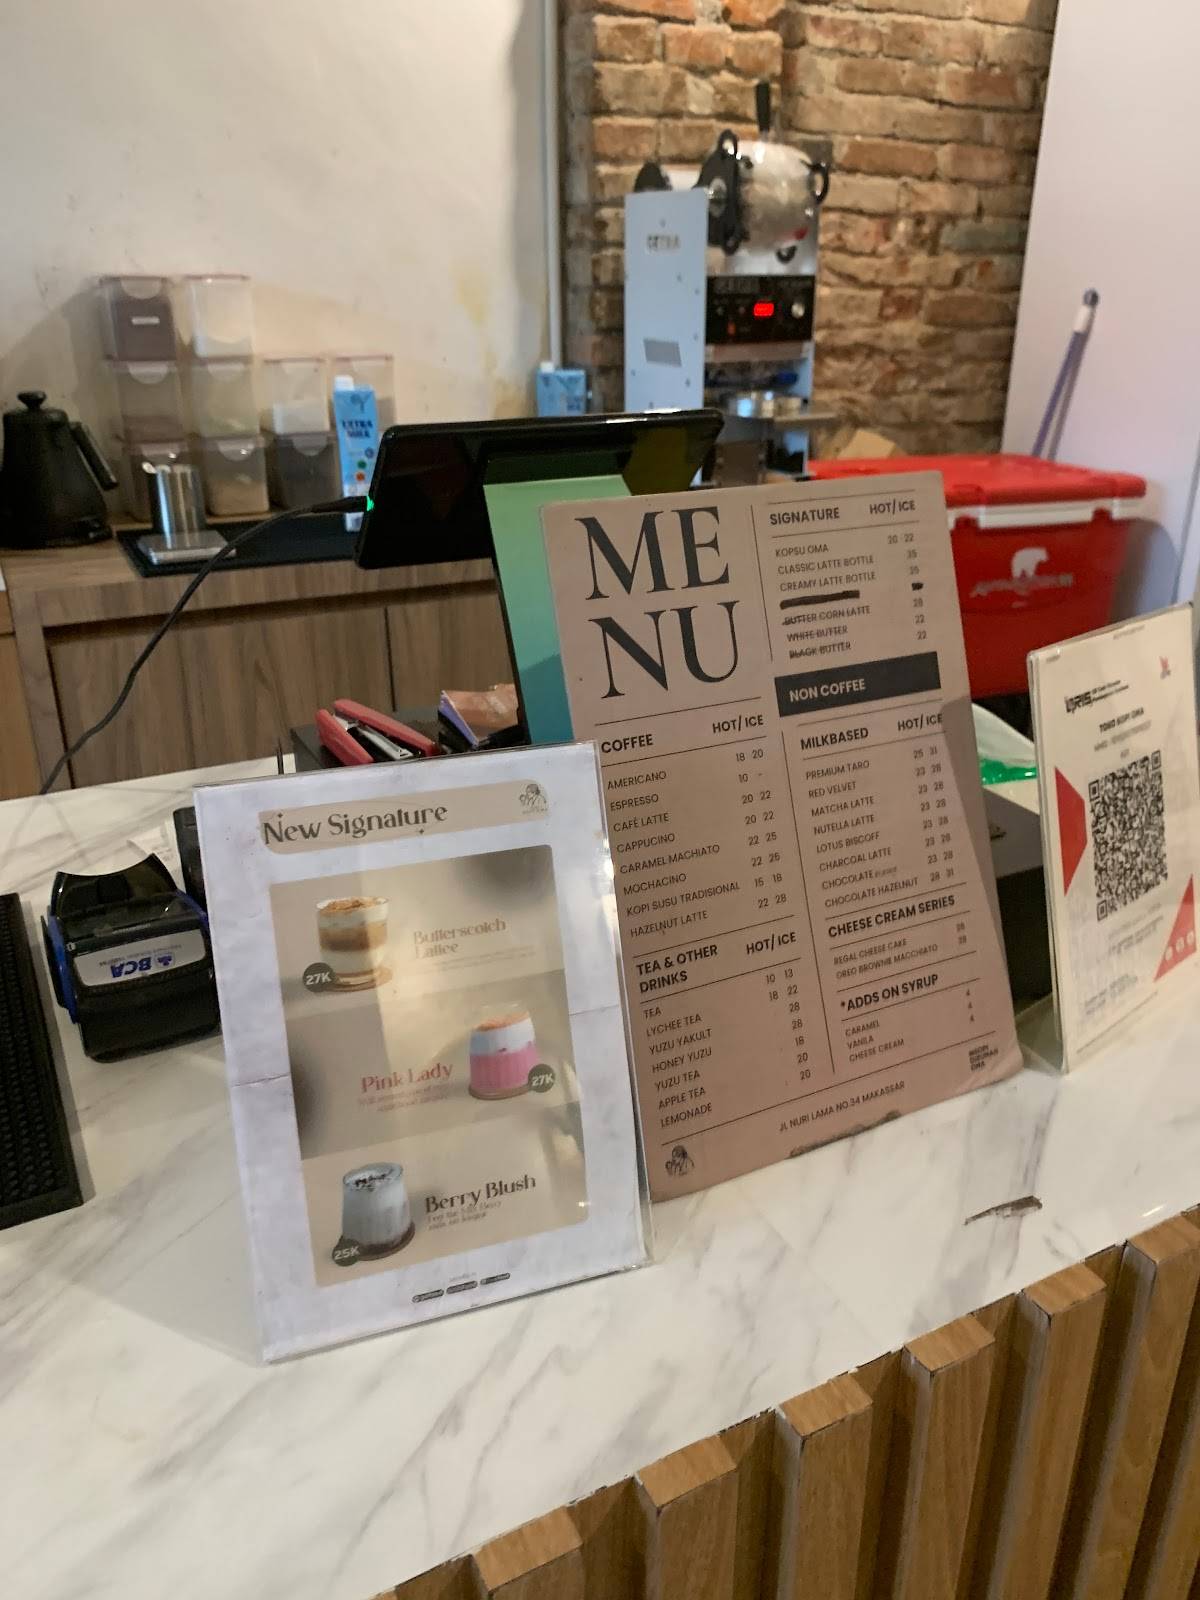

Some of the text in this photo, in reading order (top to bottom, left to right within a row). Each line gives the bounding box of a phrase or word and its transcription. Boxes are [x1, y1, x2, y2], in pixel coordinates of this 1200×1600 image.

[770, 499, 915, 525] SIGNATURE HOT/ ICE
[575, 506, 729, 600] ME
[775, 533, 914, 557] KOPSU OMA 20 22
[778, 556, 874, 575] CLASSIC LATTE BOTTLE
[780, 572, 876, 592] CREAMY LATTE BOTTLE
[819, 609, 844, 620] CORN
[847, 605, 870, 616] LATTE
[588, 600, 740, 698] NU
[789, 678, 866, 702] NON COFFEE
[601, 715, 763, 753] COFFEE HOT/ ICE
[800, 713, 943, 751] MILKBASED HOT/ ICE
[608, 749, 763, 790] AMERICANO 18 20
[806, 760, 870, 780] PREMIUM TARO
[611, 773, 748, 812] ESPRESSO 10
[809, 788, 825, 798] RED
[827, 781, 856, 795] VELVET
[613, 791, 771, 832] CAFÉ LATTE 20 22
[811, 802, 848, 817] MATCHA
[850, 796, 875, 808] LATTE
[263, 806, 448, 845] New Signature
[617, 811, 774, 853] CAPPUCINO 20 22
[814, 820, 849, 835] NUTELLA
[851, 814, 875, 827] LATTE
[620, 857, 666, 874] CARAMEL
[669, 844, 720, 863] MACHIATO
[748, 835, 760, 846] 22
[817, 840, 843, 853] LOTUS
[846, 832, 880, 847] BISCOFF
[819, 856, 867, 872] CHARCOAL
[869, 847, 892, 860] LATTE
[623, 873, 687, 895] MOCHACINO
[752, 856, 762, 867] 22
[822, 870, 874, 890] CHOCOLATE
[626, 902, 650, 917] KOPI
[652, 896, 677, 910] SUSU
[680, 882, 740, 904] TRADISIONAL
[825, 877, 918, 908] CHOCOLATE HAZELNUT
[630, 919, 678, 938] HAZELNUT
[681, 910, 708, 924] LATTE
[758, 898, 768, 908] 22
[828, 895, 955, 937] CHEESE CREAM SERIES
[414, 918, 506, 944] Butterscotch
[636, 932, 796, 976] TEA & OTHER HOT/ ICE
[834, 939, 906, 965] REGAL CHEESE CAKE
[110, 957, 152, 978] BCA
[306, 972, 332, 985] 27K
[836, 967, 857, 979] OREO
[640, 971, 688, 993] DRINKS
[882, 985, 899, 1000] ON
[902, 974, 938, 994] SYRUP
[643, 1007, 661, 1019] TEA
[766, 974, 776, 984] 10
[646, 1020, 681, 1037] LYCHEE
[685, 1014, 702, 1026] TEA
[787, 985, 798, 995] 22
[845, 1020, 880, 1036] CARAMEL
[649, 1039, 674, 1055] YUZU
[676, 1029, 711, 1046] YAKULT
[849, 1047, 876, 1062] CHEESE
[652, 1056, 684, 1073] HONEY
[687, 1048, 712, 1062] YUZU
[360, 1062, 454, 1093] Pink Lady
[532, 1072, 554, 1087] 27K
[654, 1076, 680, 1092] YUZU
[683, 1070, 700, 1082] TEA
[658, 1052, 808, 1110] APPLE TEA 20
[660, 1069, 810, 1129] LEMONADE 20
[789, 1114, 810, 1128] NURI
[811, 1108, 834, 1120] LAMA
[862, 1081, 905, 1103] MAKASSAR
[425, 1174, 536, 1213] Berry Blush
[334, 1246, 360, 1260] 25K
